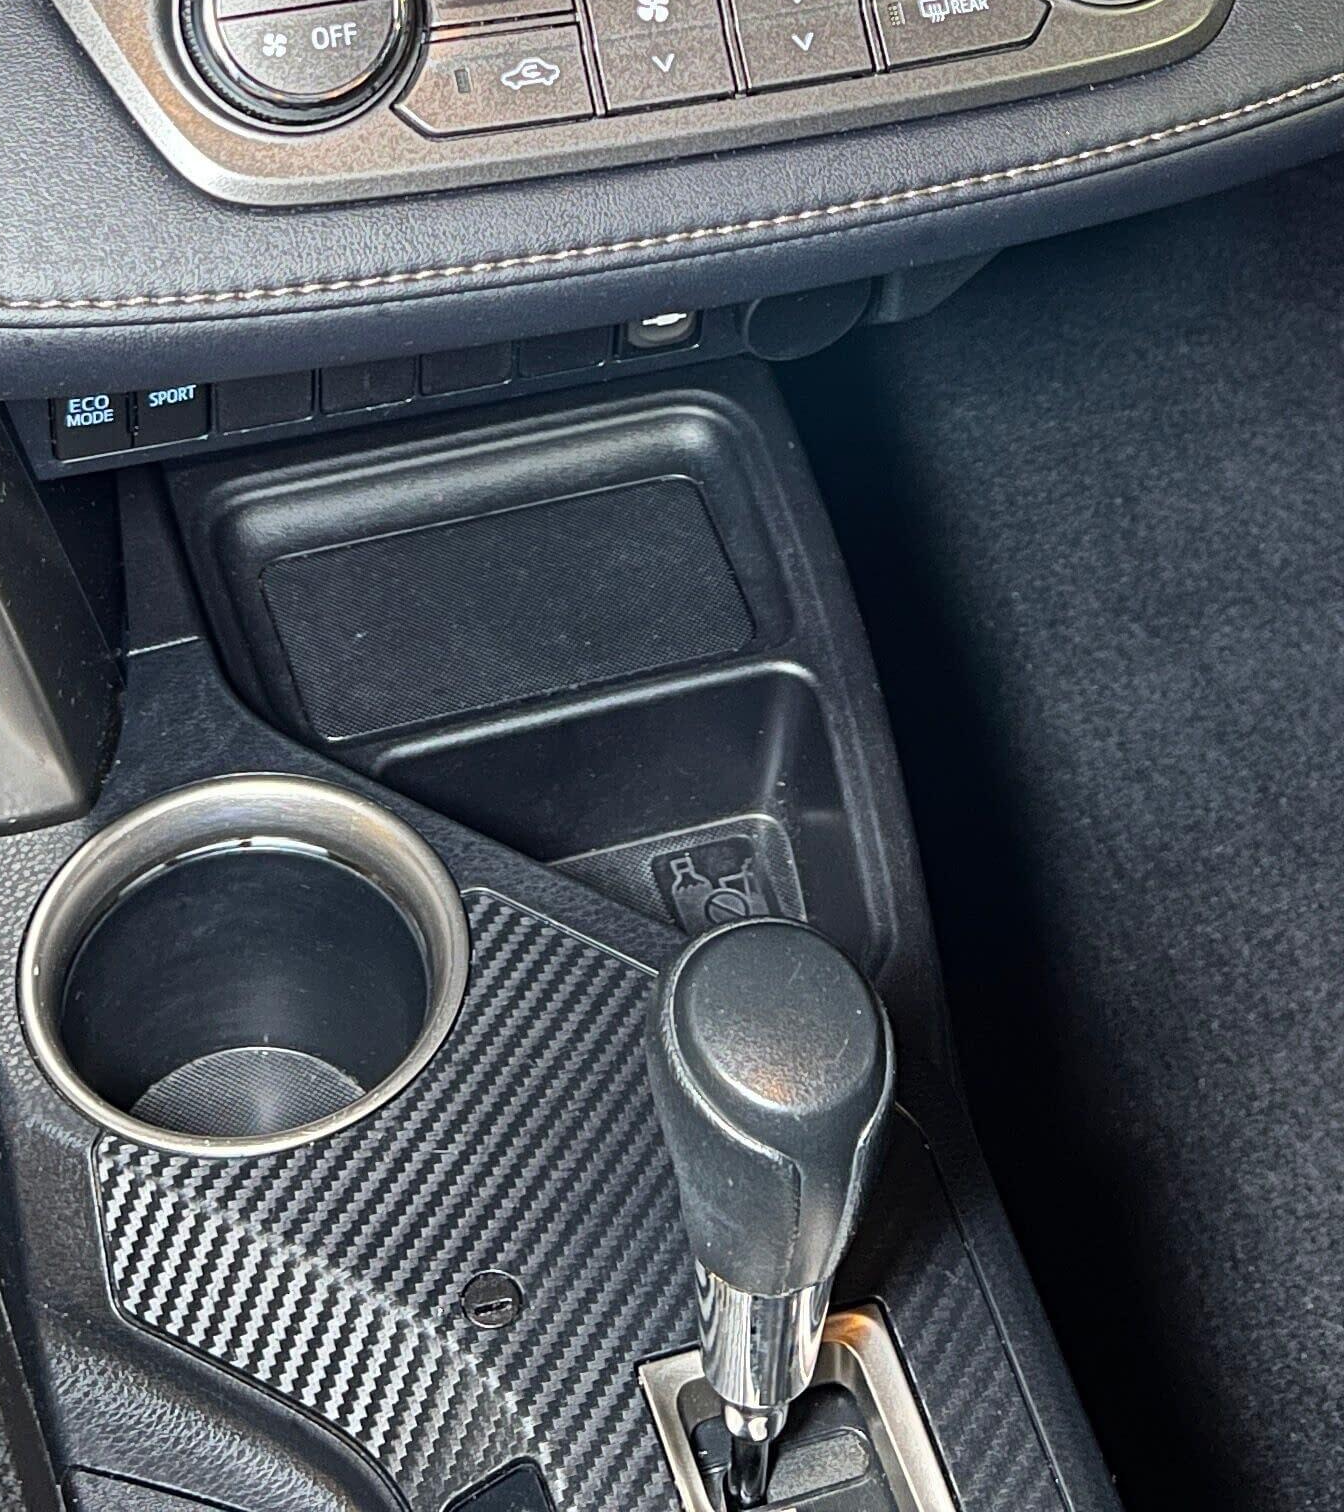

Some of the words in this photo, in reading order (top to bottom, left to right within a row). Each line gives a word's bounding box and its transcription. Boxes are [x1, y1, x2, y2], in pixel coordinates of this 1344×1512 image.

[311, 22, 357, 50] OFF
[68, 394, 110, 414] ECO
[148, 384, 197, 407] SPORT
[66, 409, 114, 428] MODE
